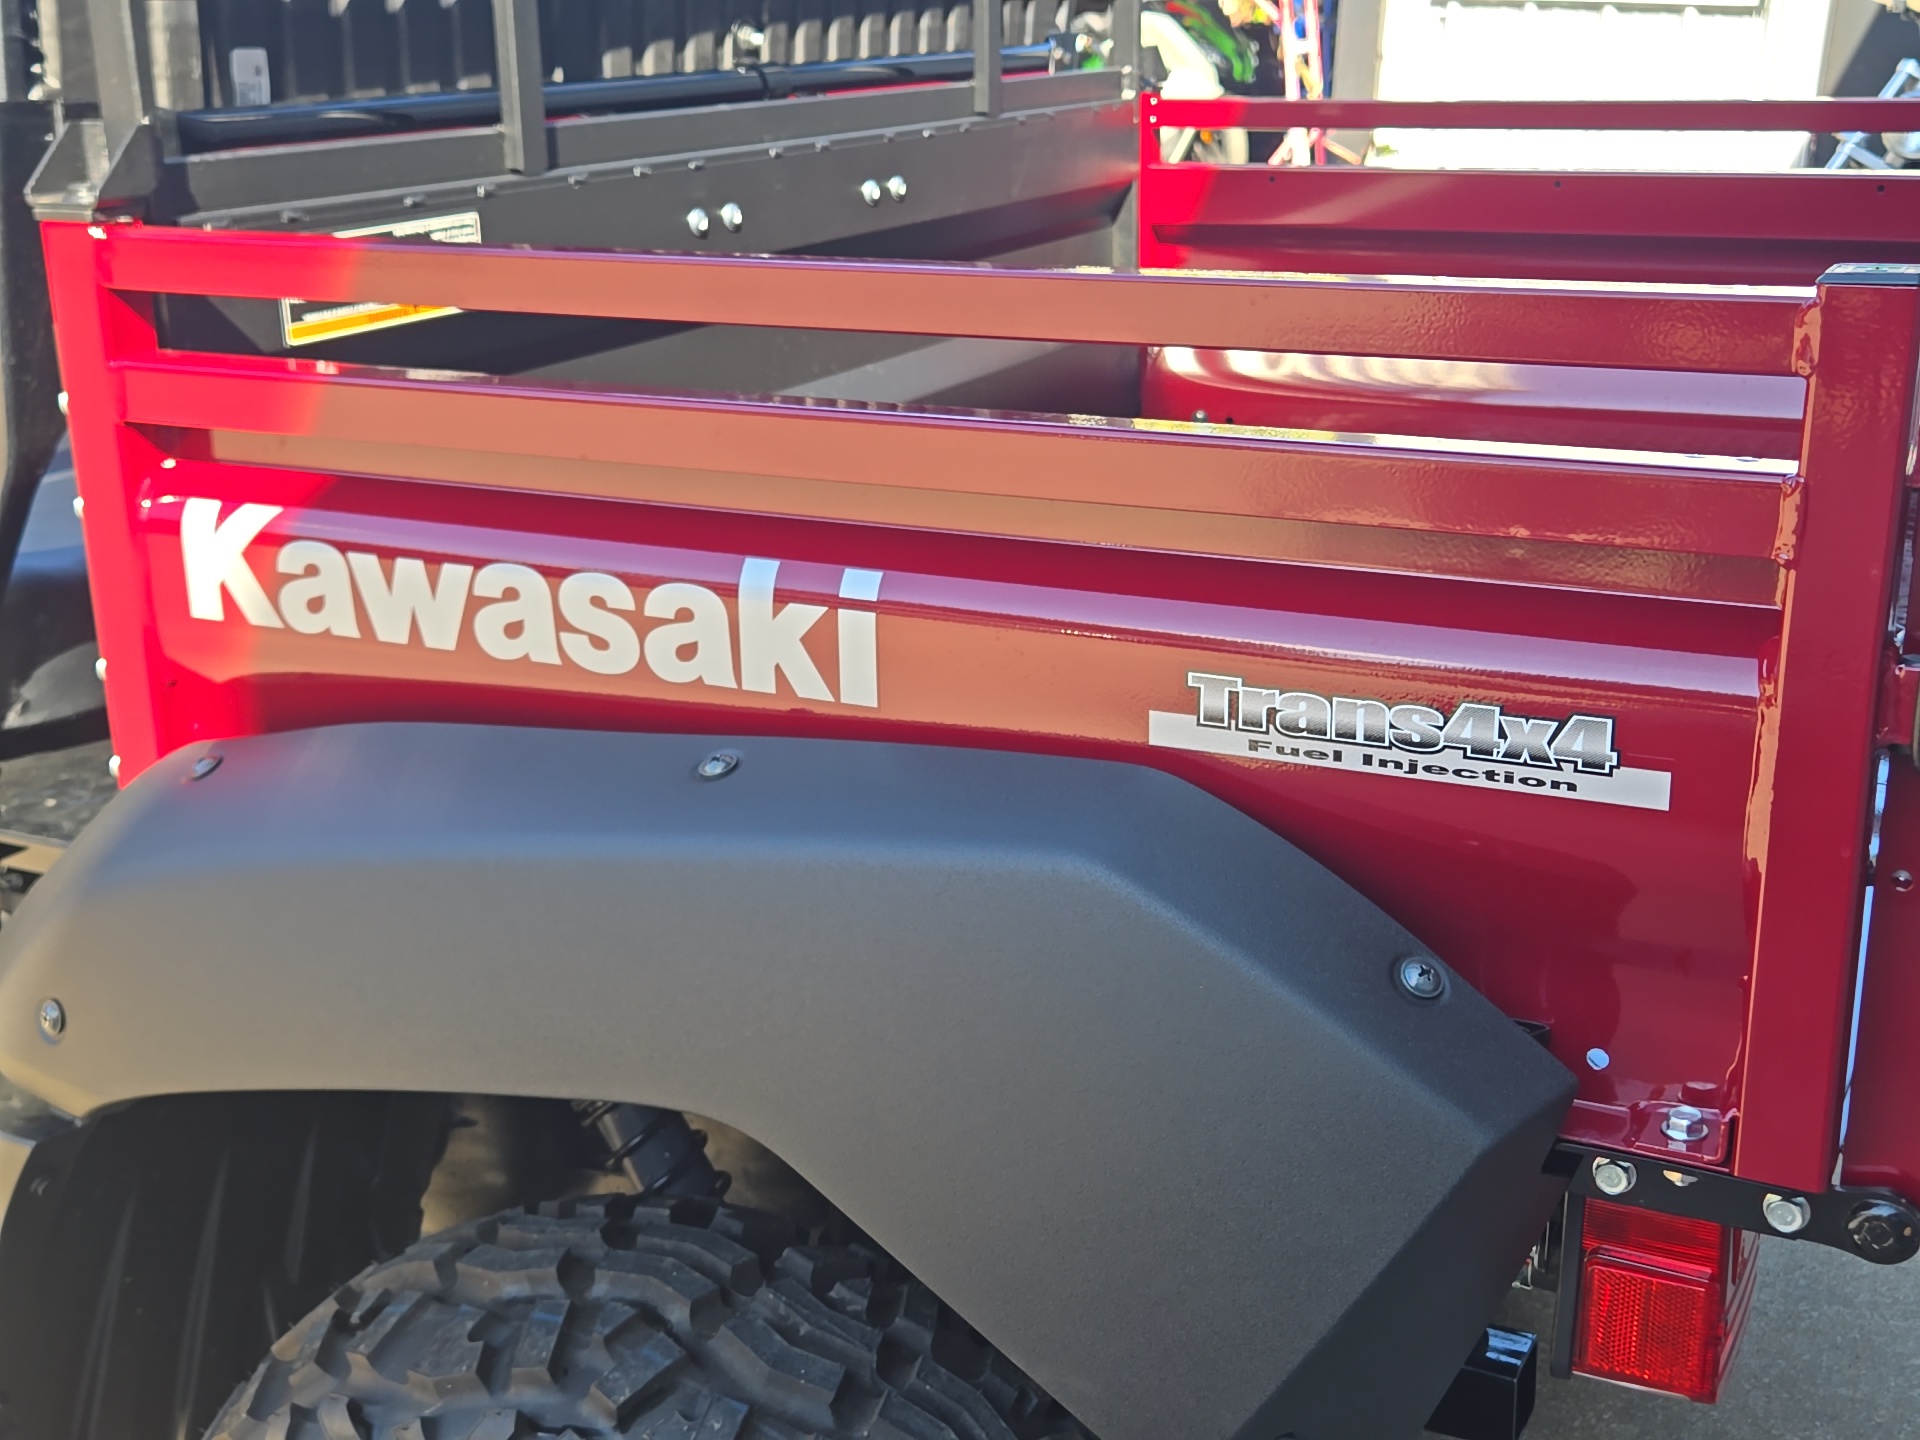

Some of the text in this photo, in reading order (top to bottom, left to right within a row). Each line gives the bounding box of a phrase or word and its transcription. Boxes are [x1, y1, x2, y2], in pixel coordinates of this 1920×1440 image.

[180, 497, 884, 707] Kawasaki
[1187, 671, 1620, 776] Trans4x4
[1248, 739, 1578, 792] Fuel Injection
